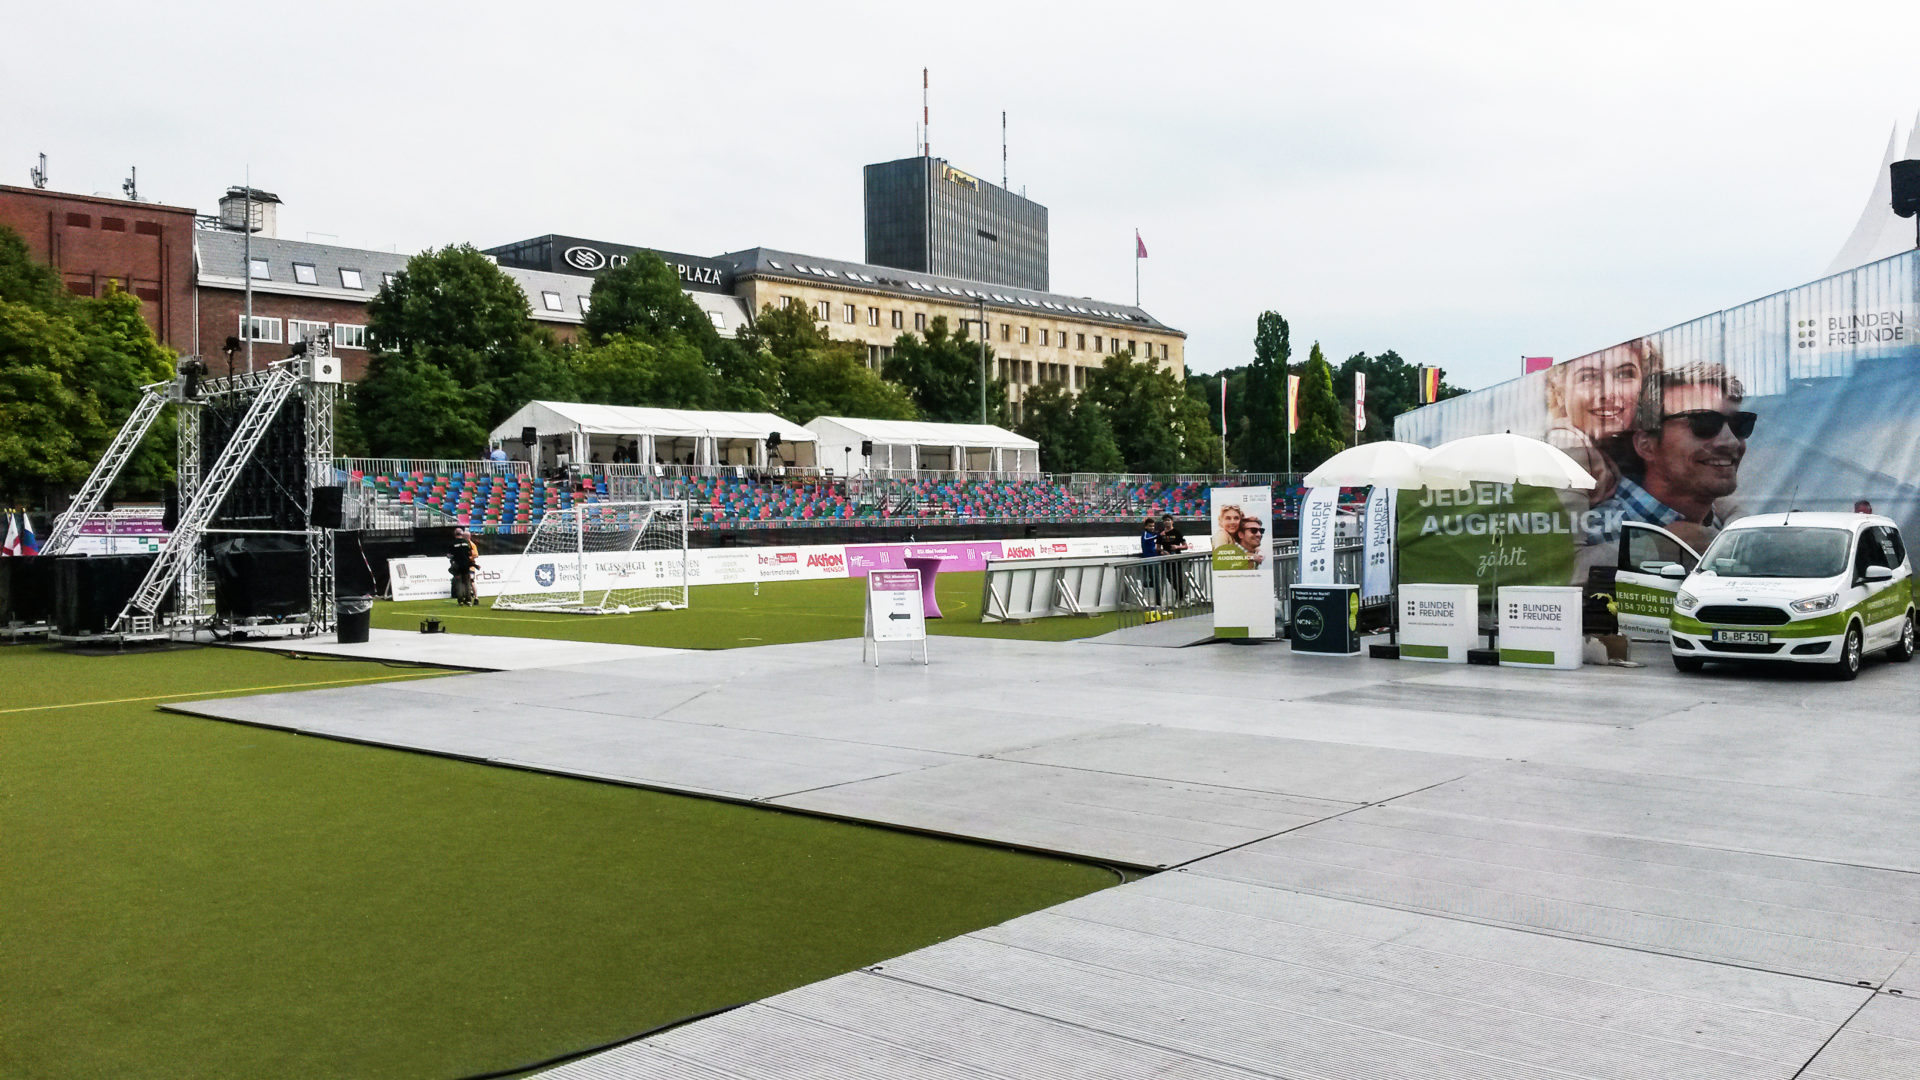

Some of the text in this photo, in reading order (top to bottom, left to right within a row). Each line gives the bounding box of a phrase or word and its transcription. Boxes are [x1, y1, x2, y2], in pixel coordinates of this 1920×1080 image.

[678, 263, 721, 285] PLAZA
[1828, 310, 1903, 331] BLINDEN
[1828, 327, 1903, 346] FREUNDE
[1419, 483, 1515, 507] JEDER
[1420, 510, 1625, 536] AUGENBLICK
[475, 570, 501, 580] rbb
[1641, 593, 1658, 603] FÜR
[1419, 601, 1454, 609] BLINDEN
[1522, 603, 1562, 613] BLINDEN
[1636, 604, 1646, 612] 70
[1648, 605, 1658, 613] 24
[1419, 609, 1454, 618] FREUNDE
[1522, 612, 1562, 622] FREUNDE
[1721, 632, 1765, 641] B BF 150
